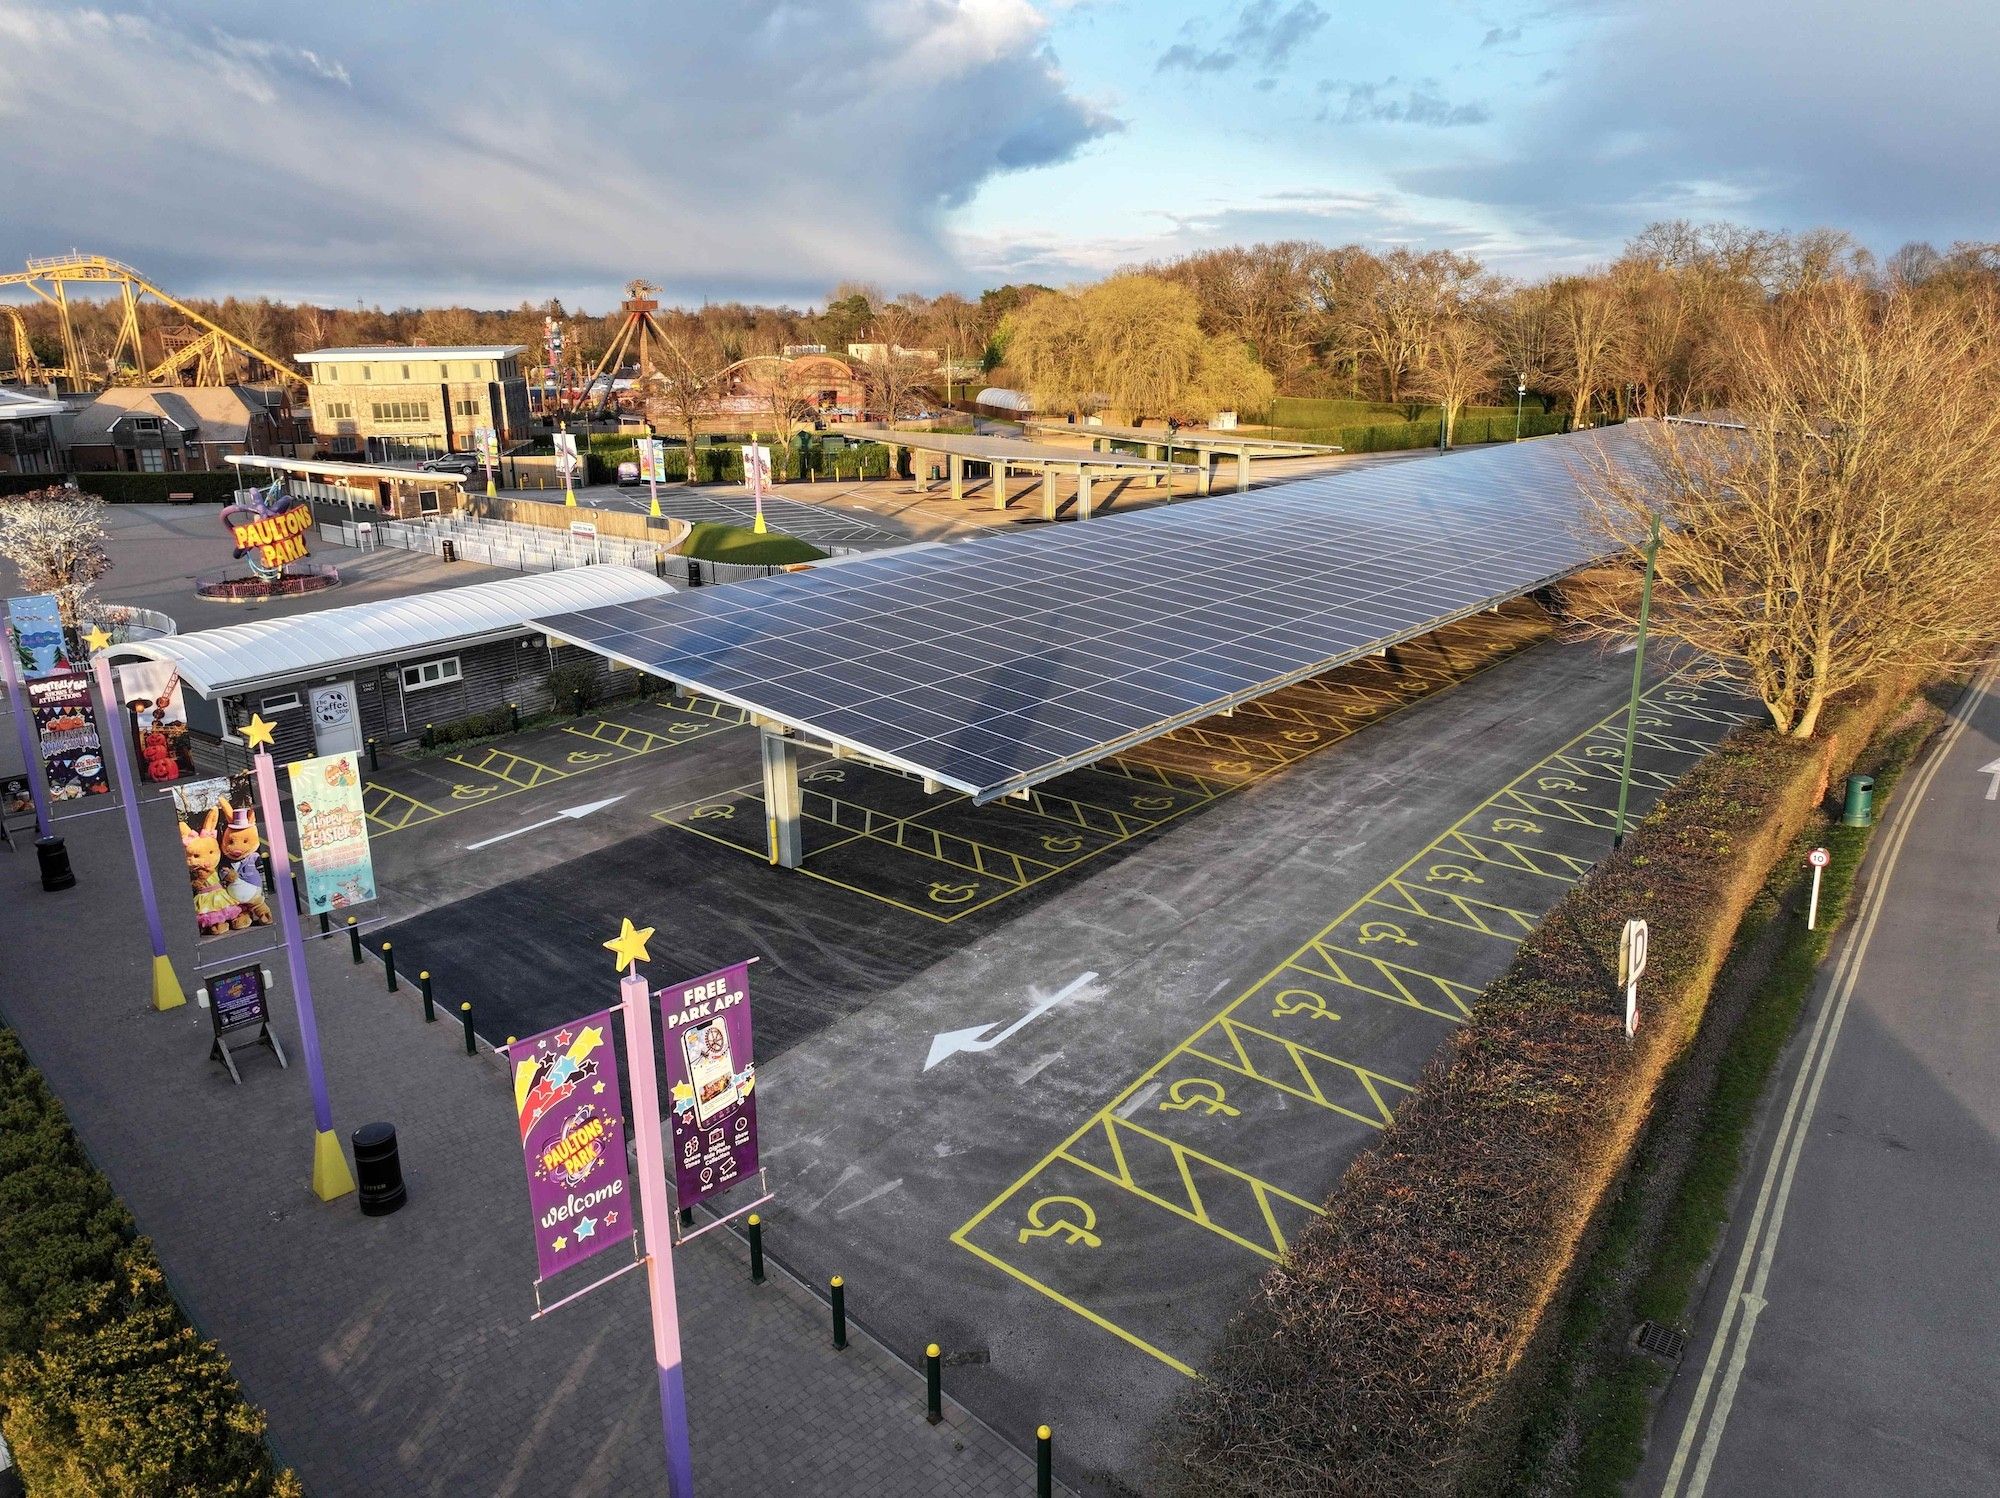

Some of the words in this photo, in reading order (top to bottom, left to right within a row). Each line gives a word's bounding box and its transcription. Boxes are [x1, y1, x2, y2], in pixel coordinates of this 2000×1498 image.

[234, 504, 313, 550] PAULTONS
[262, 534, 309, 568] PARK
[316, 701, 348, 714] Coffee
[336, 708, 350, 716] Stop
[1813, 855, 1824, 863] 10
[683, 977, 727, 1008] FREE
[668, 1001, 712, 1030] PARK
[713, 990, 744, 1013] APP
[734, 1130, 749, 1140] Show
[734, 1136, 750, 1147] Times
[543, 1118, 604, 1171] PAULTONS
[708, 1140, 726, 1153] Digital
[564, 1143, 597, 1176] PARK
[683, 1152, 702, 1164] Queue
[703, 1152, 716, 1161] Ride
[715, 1145, 732, 1156] Photo
[704, 1151, 731, 1166] Collection
[684, 1159, 701, 1170] Times
[719, 1171, 738, 1183] Tickets
[700, 1182, 714, 1193] Map
[541, 1179, 624, 1229] welcome
